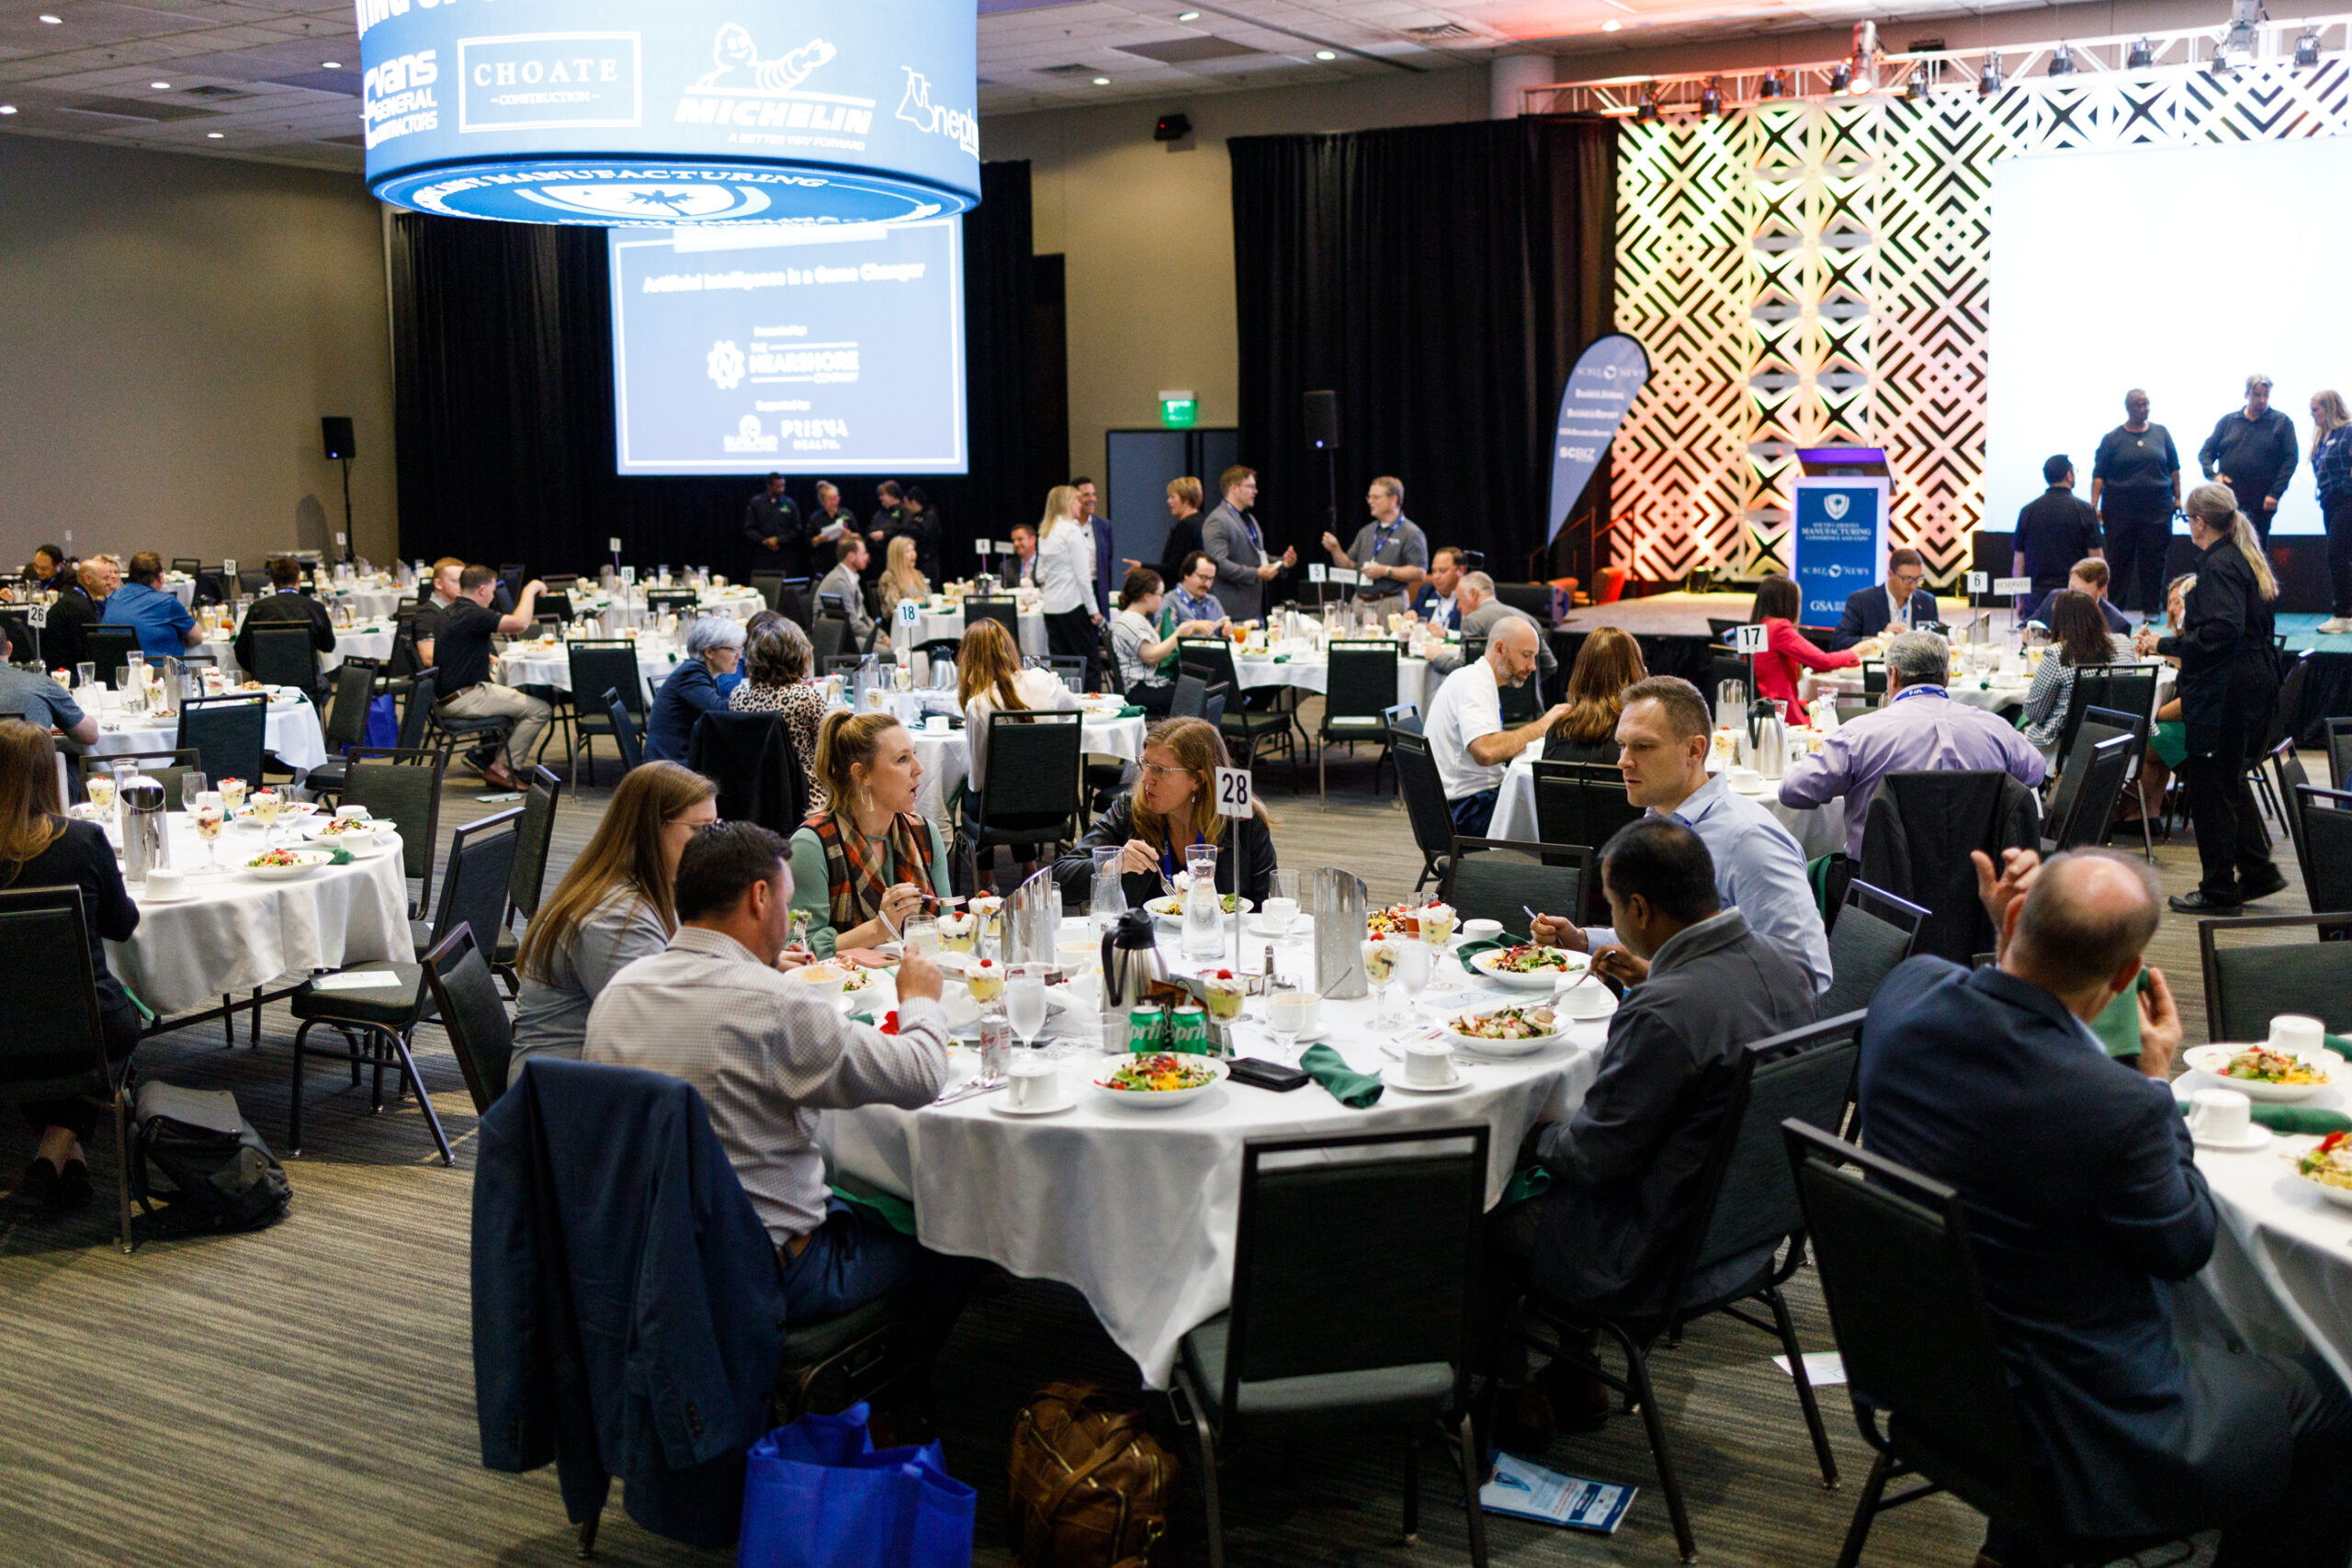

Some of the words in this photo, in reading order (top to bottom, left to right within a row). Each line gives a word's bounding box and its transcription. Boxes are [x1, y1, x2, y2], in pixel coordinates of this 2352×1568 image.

[473, 58, 618, 87] CHOATE
[375, 87, 438, 122] GENERAL
[673, 97, 873, 135] MICHELIN
[740, 133, 786, 145] BETTER
[787, 135, 813, 147] WAY
[813, 137, 866, 152] FORWARD
[481, 169, 830, 187] MANUFACTURING
[749, 351, 860, 373] NEARSHORE
[1802, 527, 1871, 536] MANUFACTURING
[1973, 573, 1981, 587] 6
[1996, 580, 2030, 589] RESERVED
[30, 606, 44, 622] 26
[902, 605, 916, 620] 18
[1810, 600, 1835, 612] GSA
[1743, 626, 1760, 646] 17
[1222, 773, 1248, 805] 28
